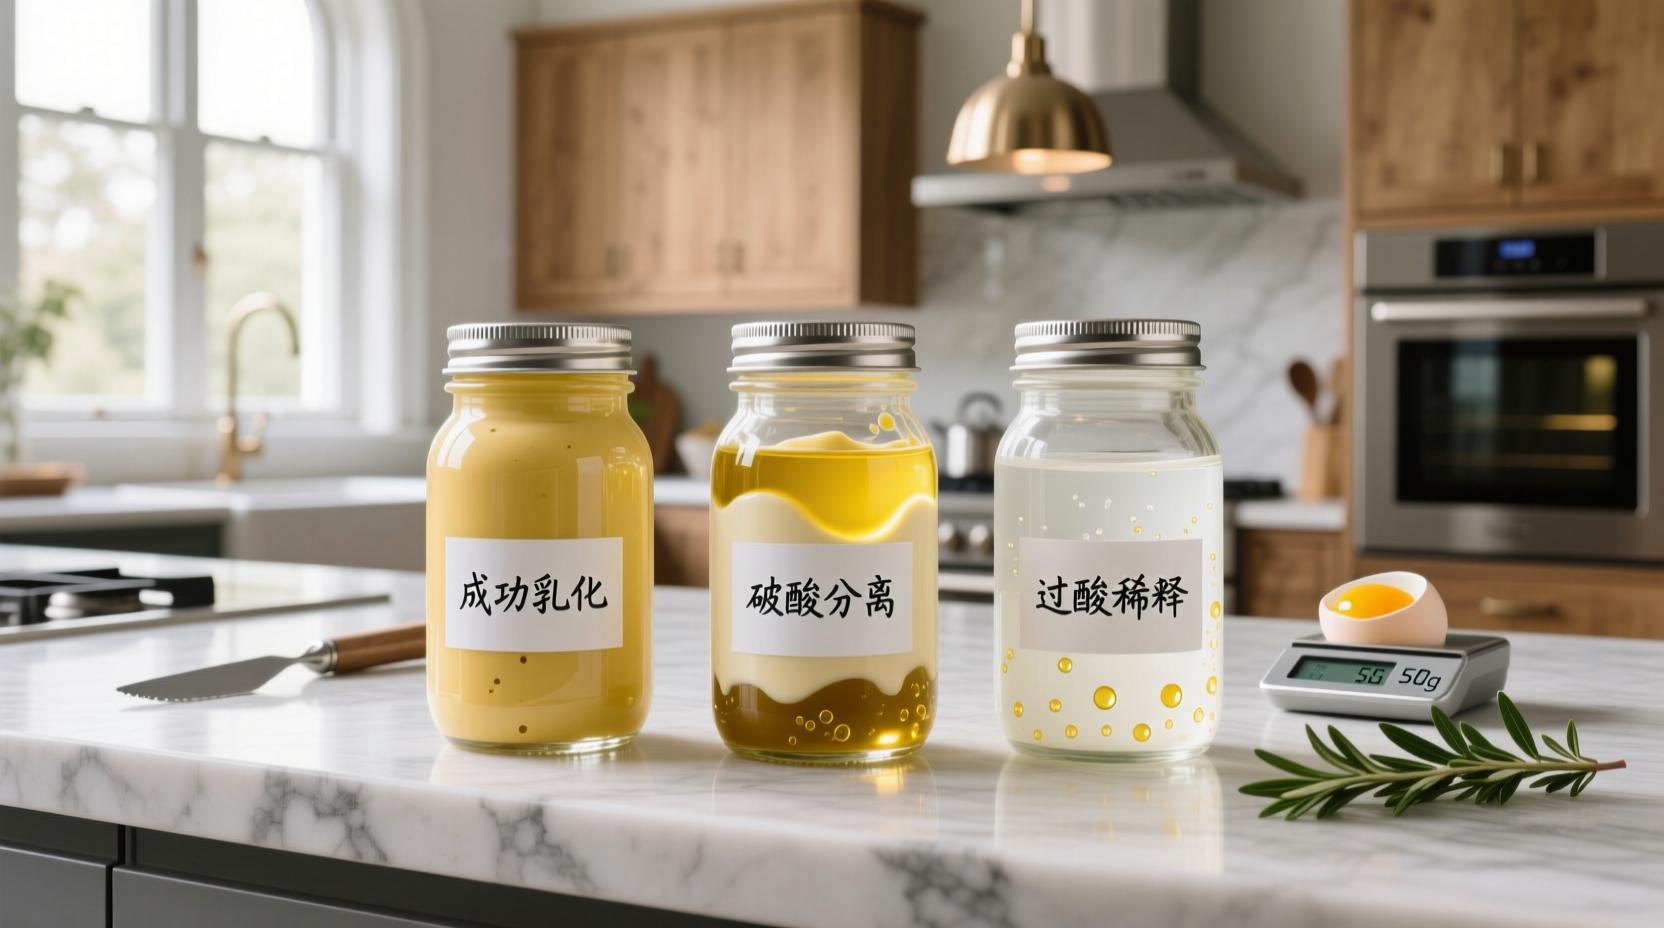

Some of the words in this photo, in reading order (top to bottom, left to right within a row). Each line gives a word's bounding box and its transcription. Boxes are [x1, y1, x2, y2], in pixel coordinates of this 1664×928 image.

[459, 571, 609, 617] 成功乳化
[745, 574, 895, 619] 破酸分离
[1035, 573, 1189, 621] 过酸稀释
[1398, 667, 1442, 693] 50g
